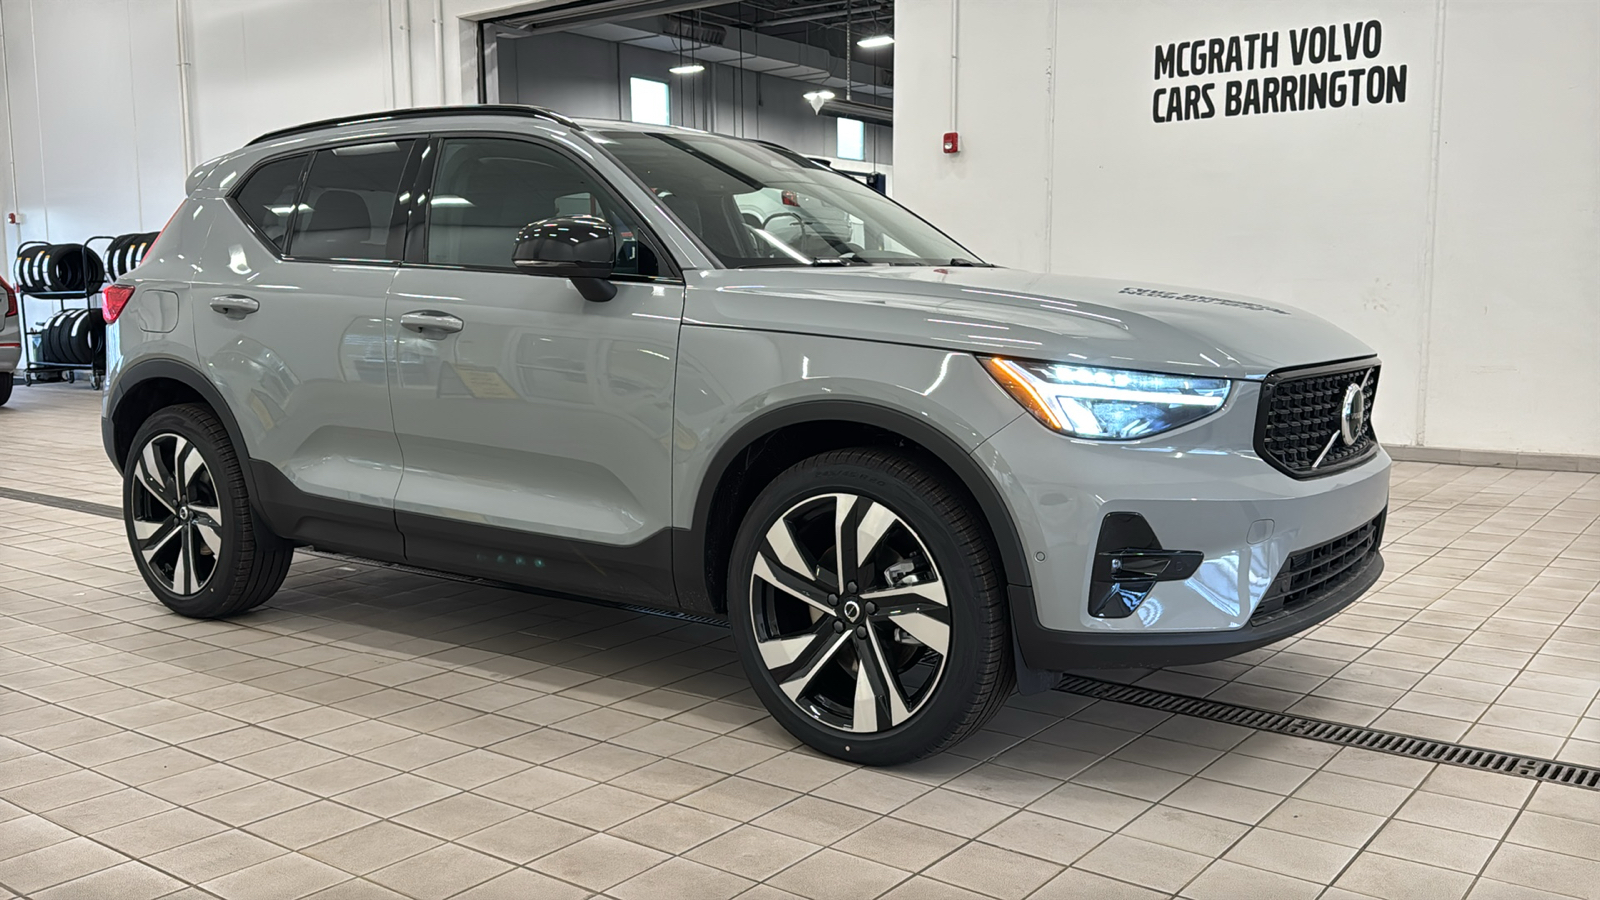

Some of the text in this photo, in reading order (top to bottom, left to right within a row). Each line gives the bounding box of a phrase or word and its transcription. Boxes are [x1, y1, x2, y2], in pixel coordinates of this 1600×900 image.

[1155, 20, 1381, 80] MCGRATH VOLVO
[1153, 65, 1407, 123] CARS BARRINGTON
